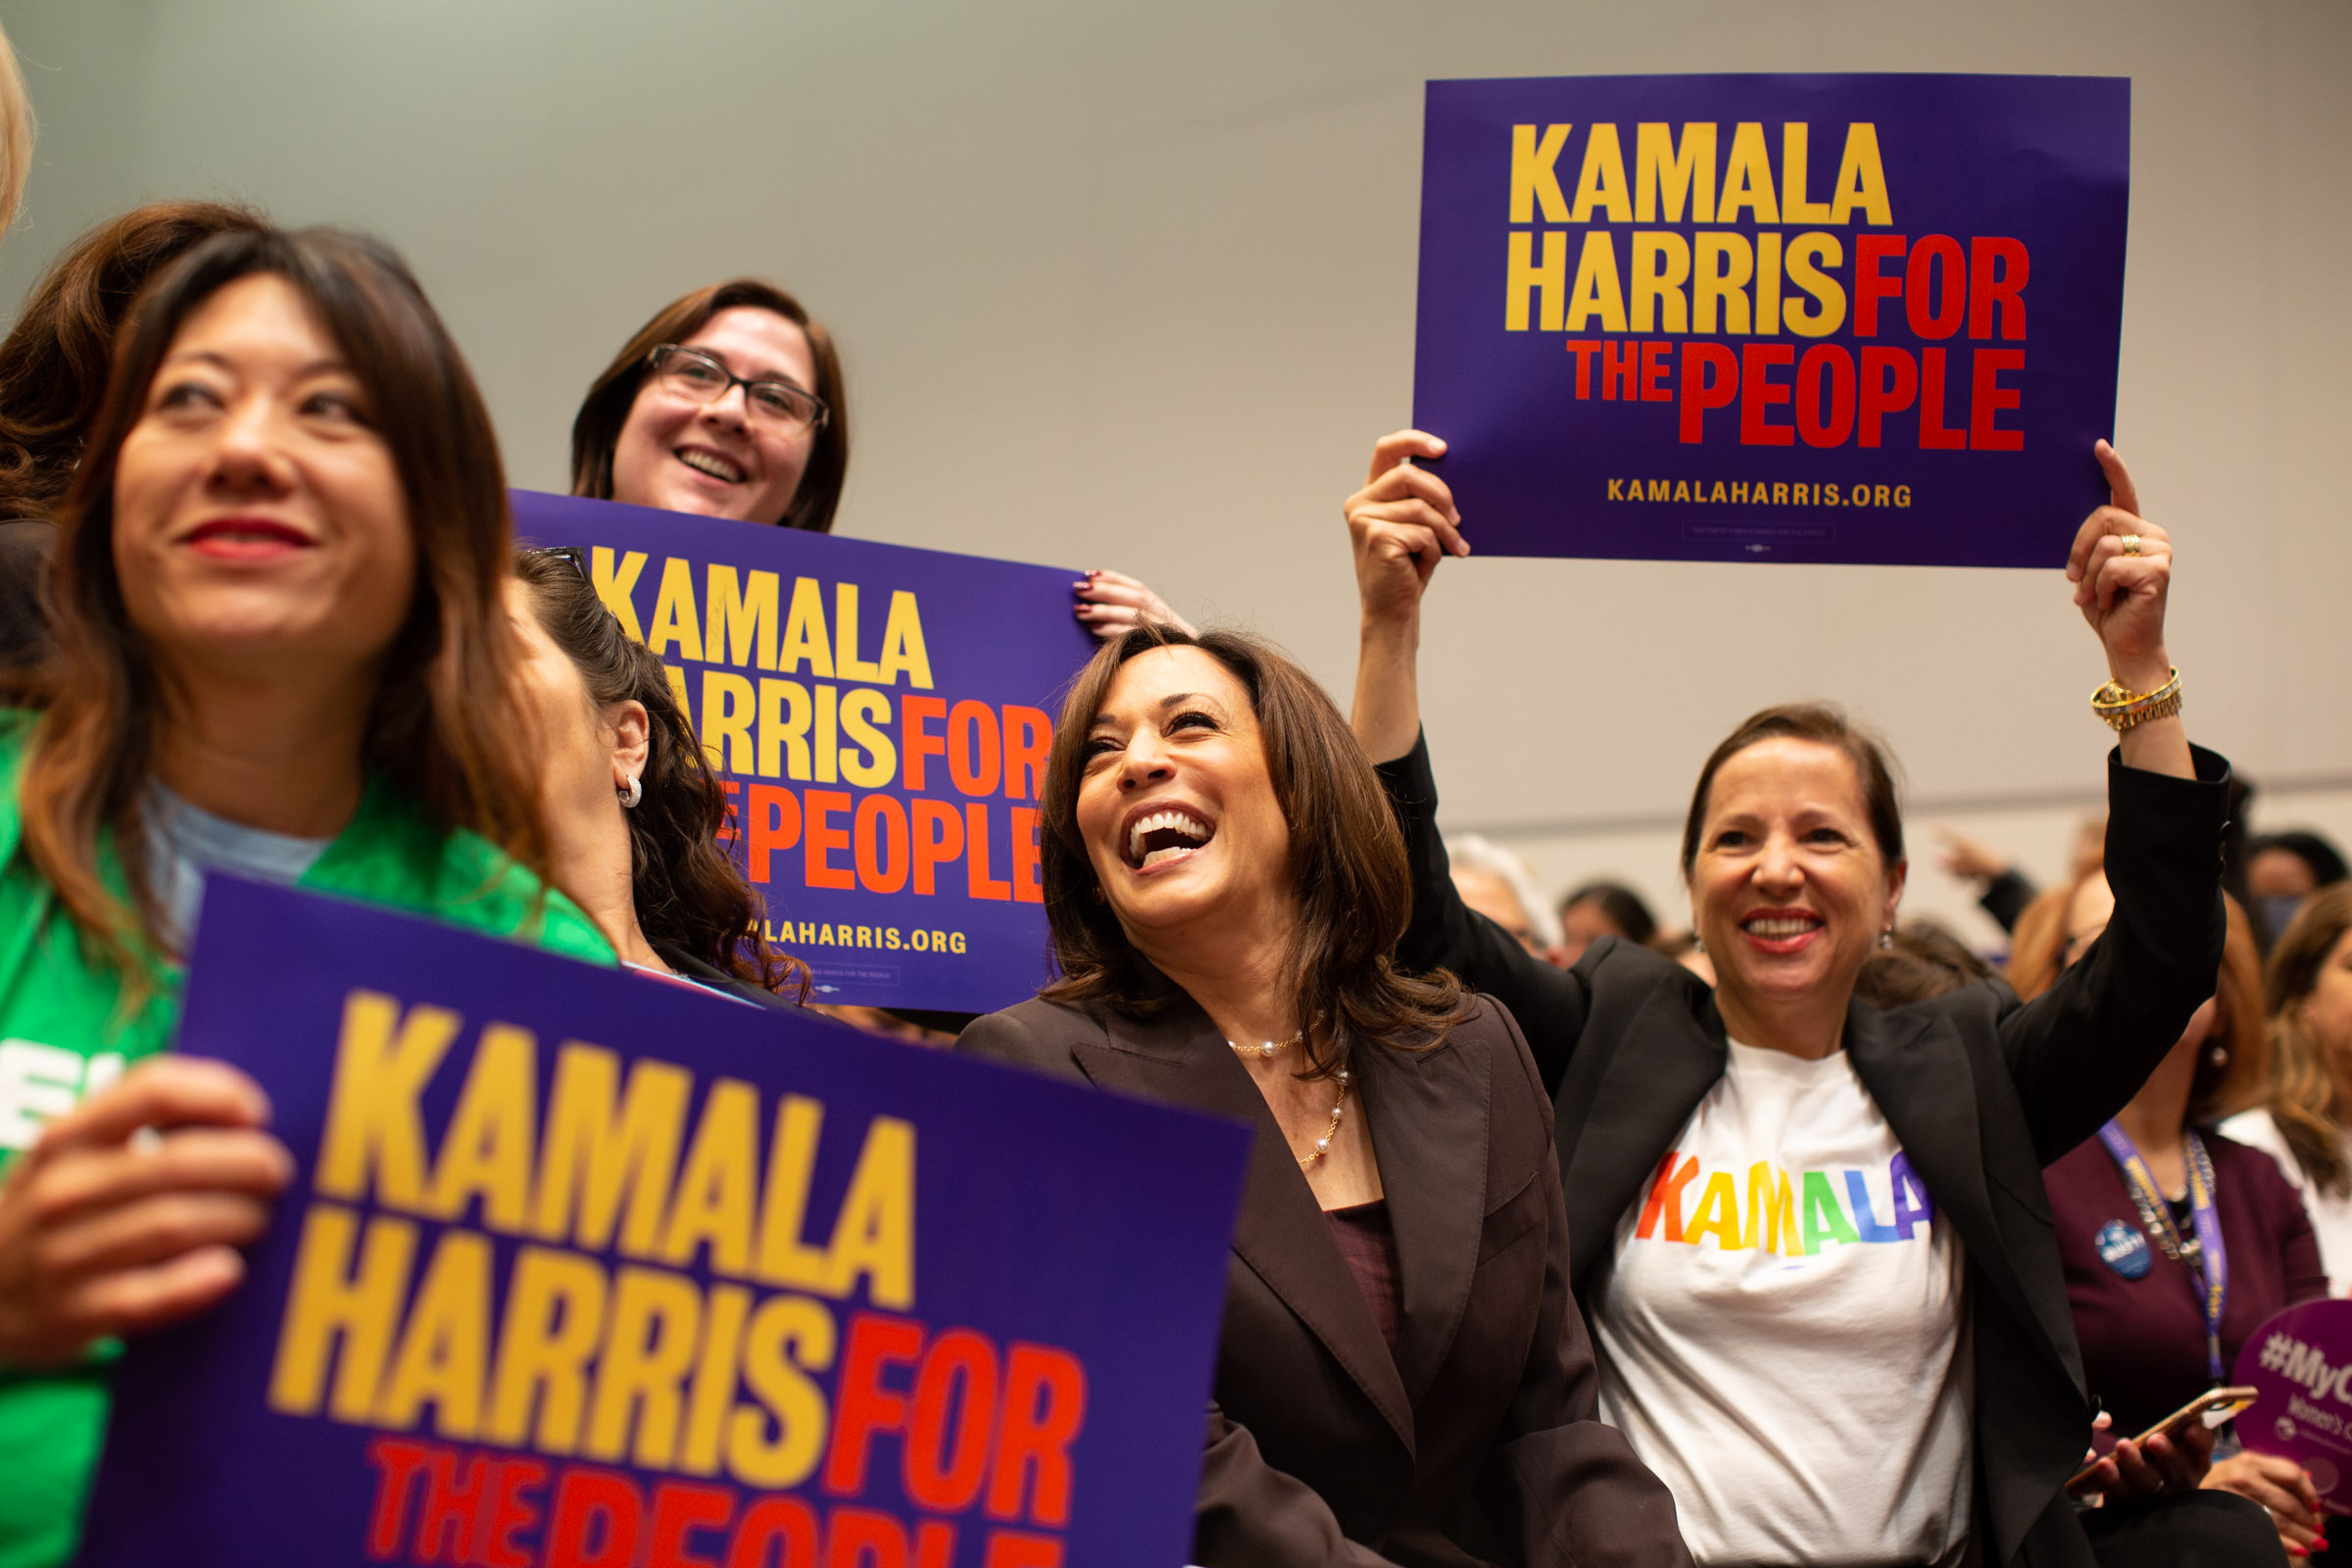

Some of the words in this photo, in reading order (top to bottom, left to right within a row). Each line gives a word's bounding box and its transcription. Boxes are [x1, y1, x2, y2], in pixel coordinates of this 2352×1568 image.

[1509, 122, 1892, 225] KAMALA
[1505, 230, 1846, 338] HARRIS
[1853, 233, 2030, 341] FOR
[1566, 339, 1673, 402] THE
[1679, 341, 2026, 451] PEOPLE
[1607, 478, 1912, 509] KAMALAHARRIS.ORG
[590, 545, 934, 689] KAMALA
[662, 664, 898, 789] RRIS
[901, 694, 1056, 802] FOR
[748, 783, 1046, 905] PEOPLE
[316, 988, 919, 1311] KAMALA
[1635, 1151, 1935, 1256] KAMALA
[269, 1202, 837, 1491] HARRIS
[823, 1311, 1085, 1528] FOR
[367, 1437, 549, 1568] THE
